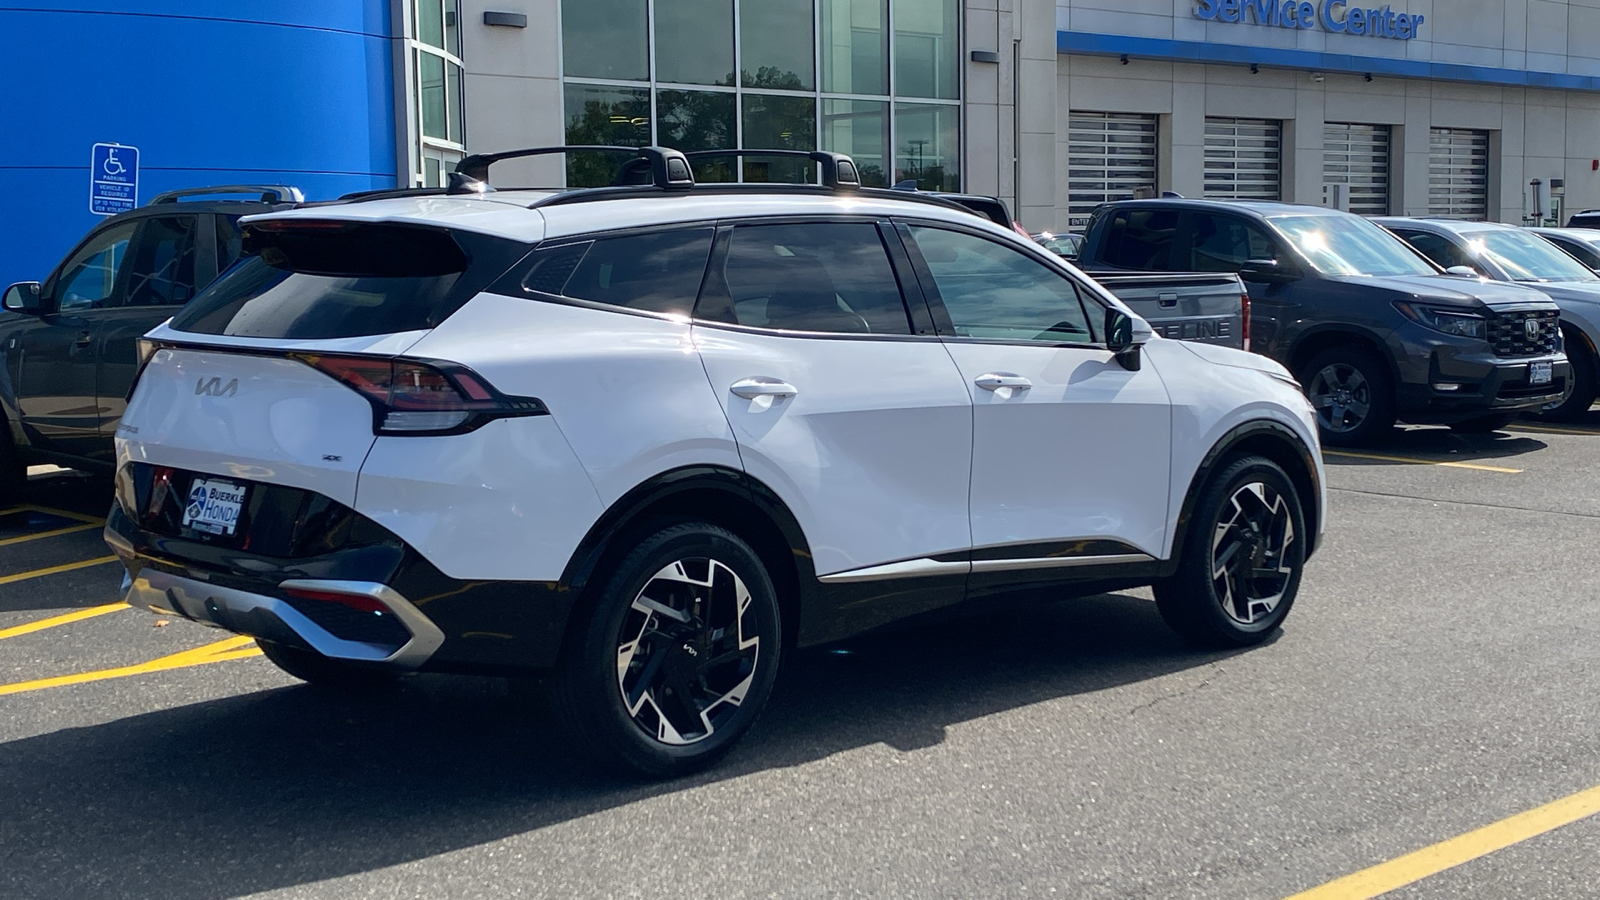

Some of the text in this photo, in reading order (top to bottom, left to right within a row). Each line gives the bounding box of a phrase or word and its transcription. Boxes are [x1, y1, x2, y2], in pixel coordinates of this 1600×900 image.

[1195, 0, 1424, 39] Service Center
[194, 376, 239, 398] KIA
[209, 488, 245, 503] BUERKLE
[203, 500, 241, 522] HONDA
